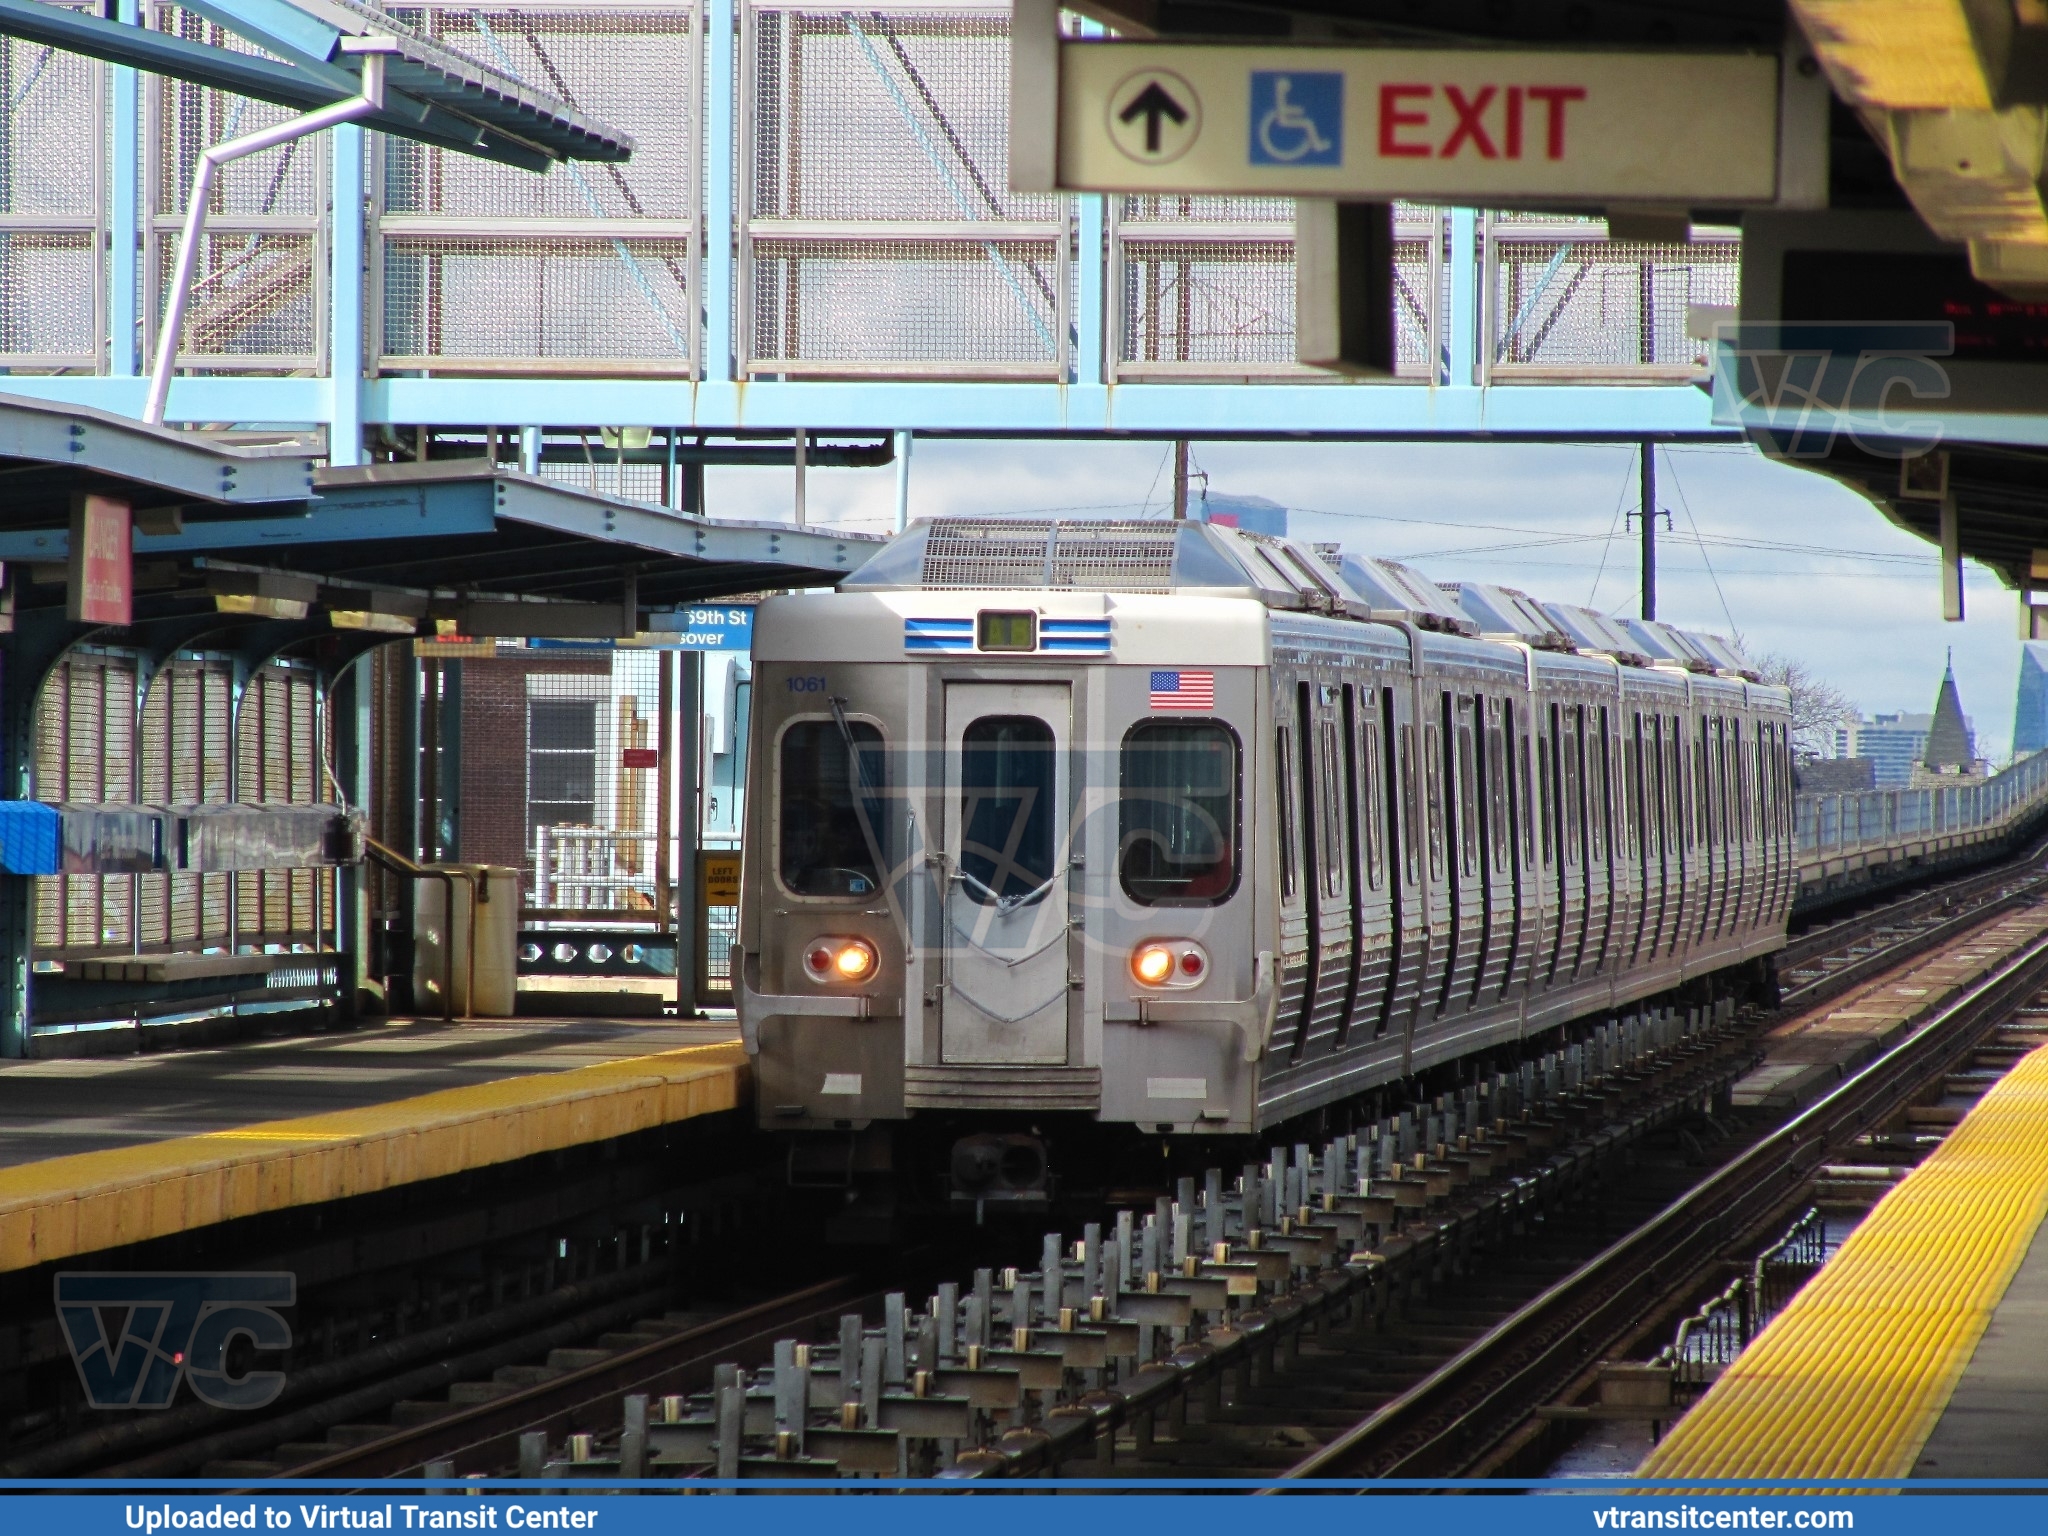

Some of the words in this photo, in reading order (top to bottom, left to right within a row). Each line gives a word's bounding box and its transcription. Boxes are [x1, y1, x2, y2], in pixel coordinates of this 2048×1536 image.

[1379, 83, 1587, 160] EXIT
[728, 610, 747, 625] St
[787, 676, 826, 692] 1061
[712, 867, 733, 876] LEFT
[708, 875, 739, 884] DOORS
